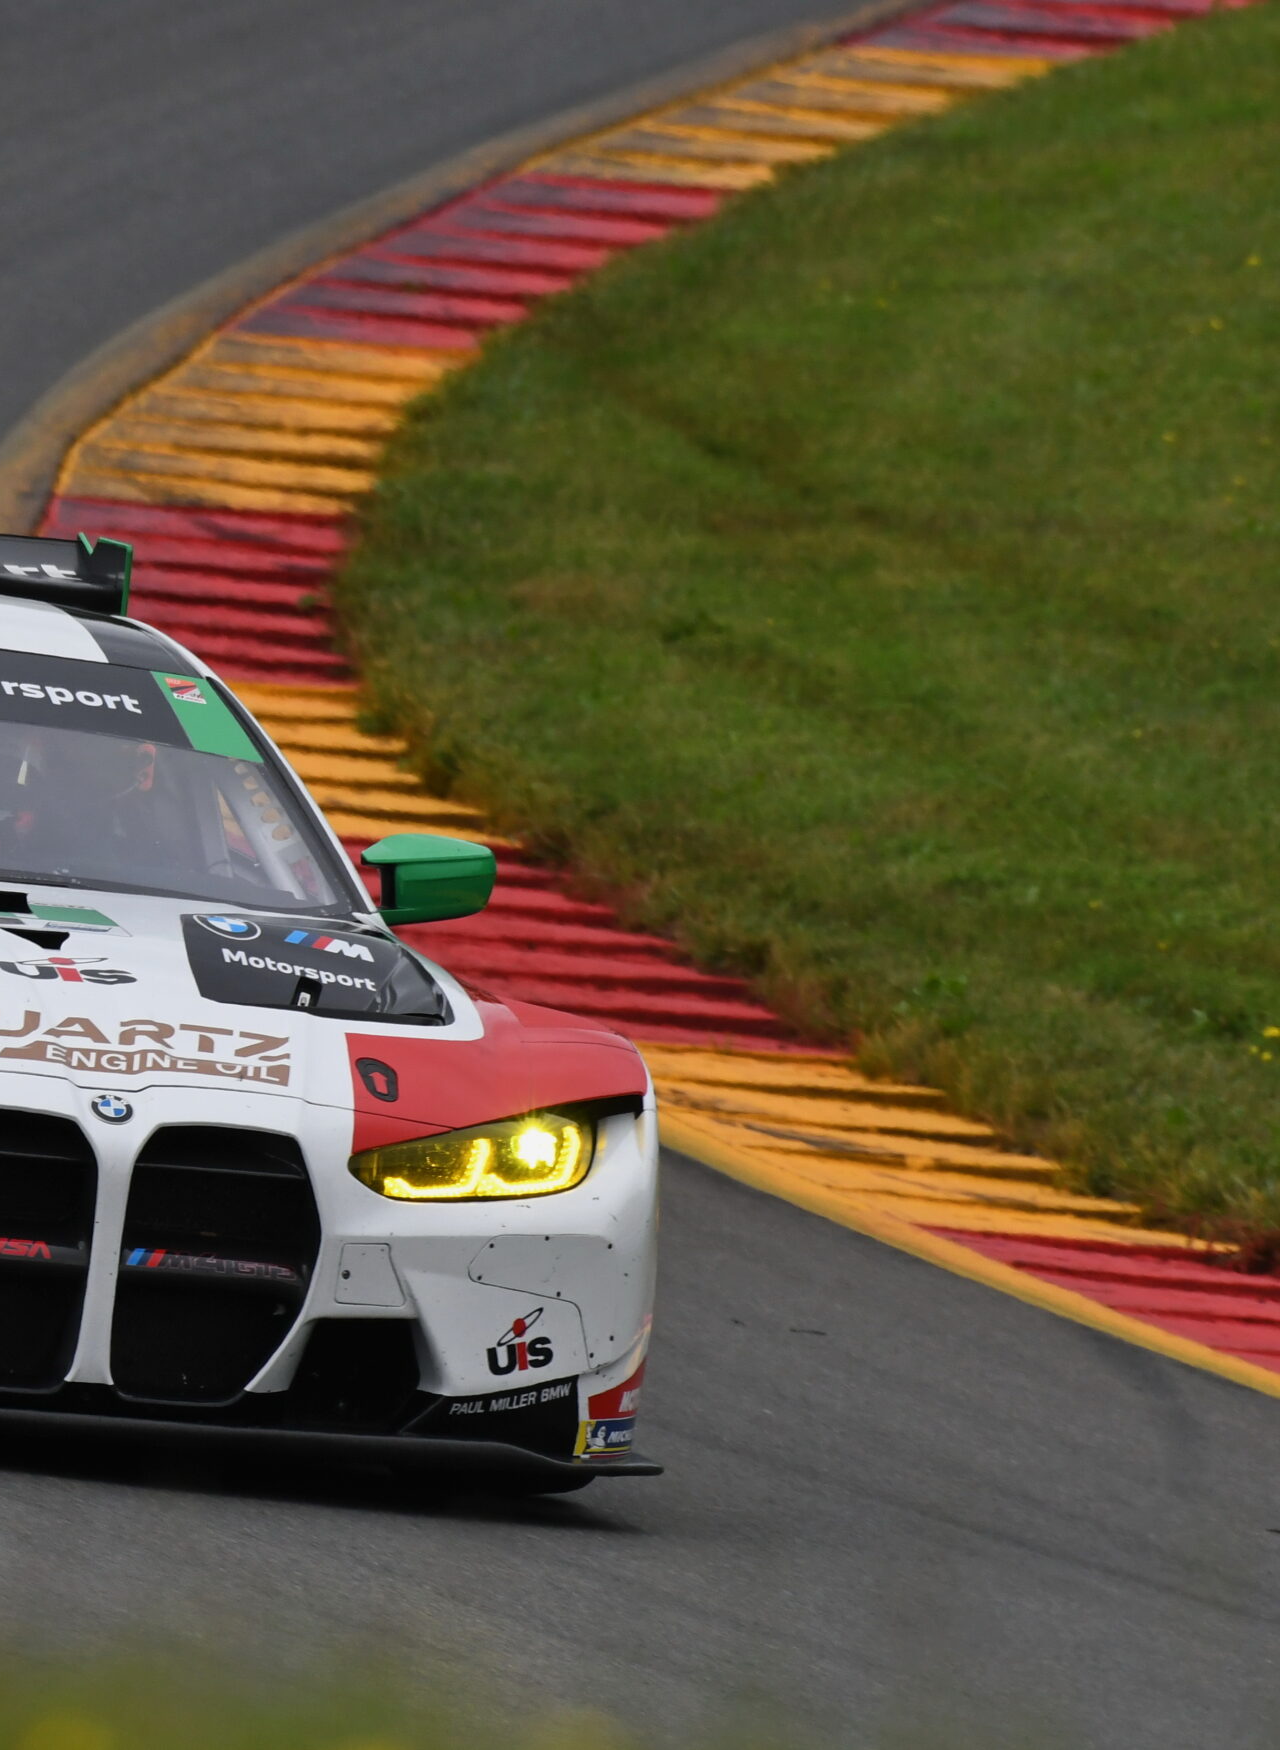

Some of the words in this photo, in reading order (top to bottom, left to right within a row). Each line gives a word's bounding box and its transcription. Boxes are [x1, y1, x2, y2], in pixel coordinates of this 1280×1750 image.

[222, 948, 377, 992] Motorsport
[46, 1044, 199, 1076] ENGINE
[215, 1063, 281, 1082] OIL
[449, 1401, 485, 1415] PAUL
[489, 1392, 537, 1412] MILLER
[540, 1383, 572, 1402] BMW
